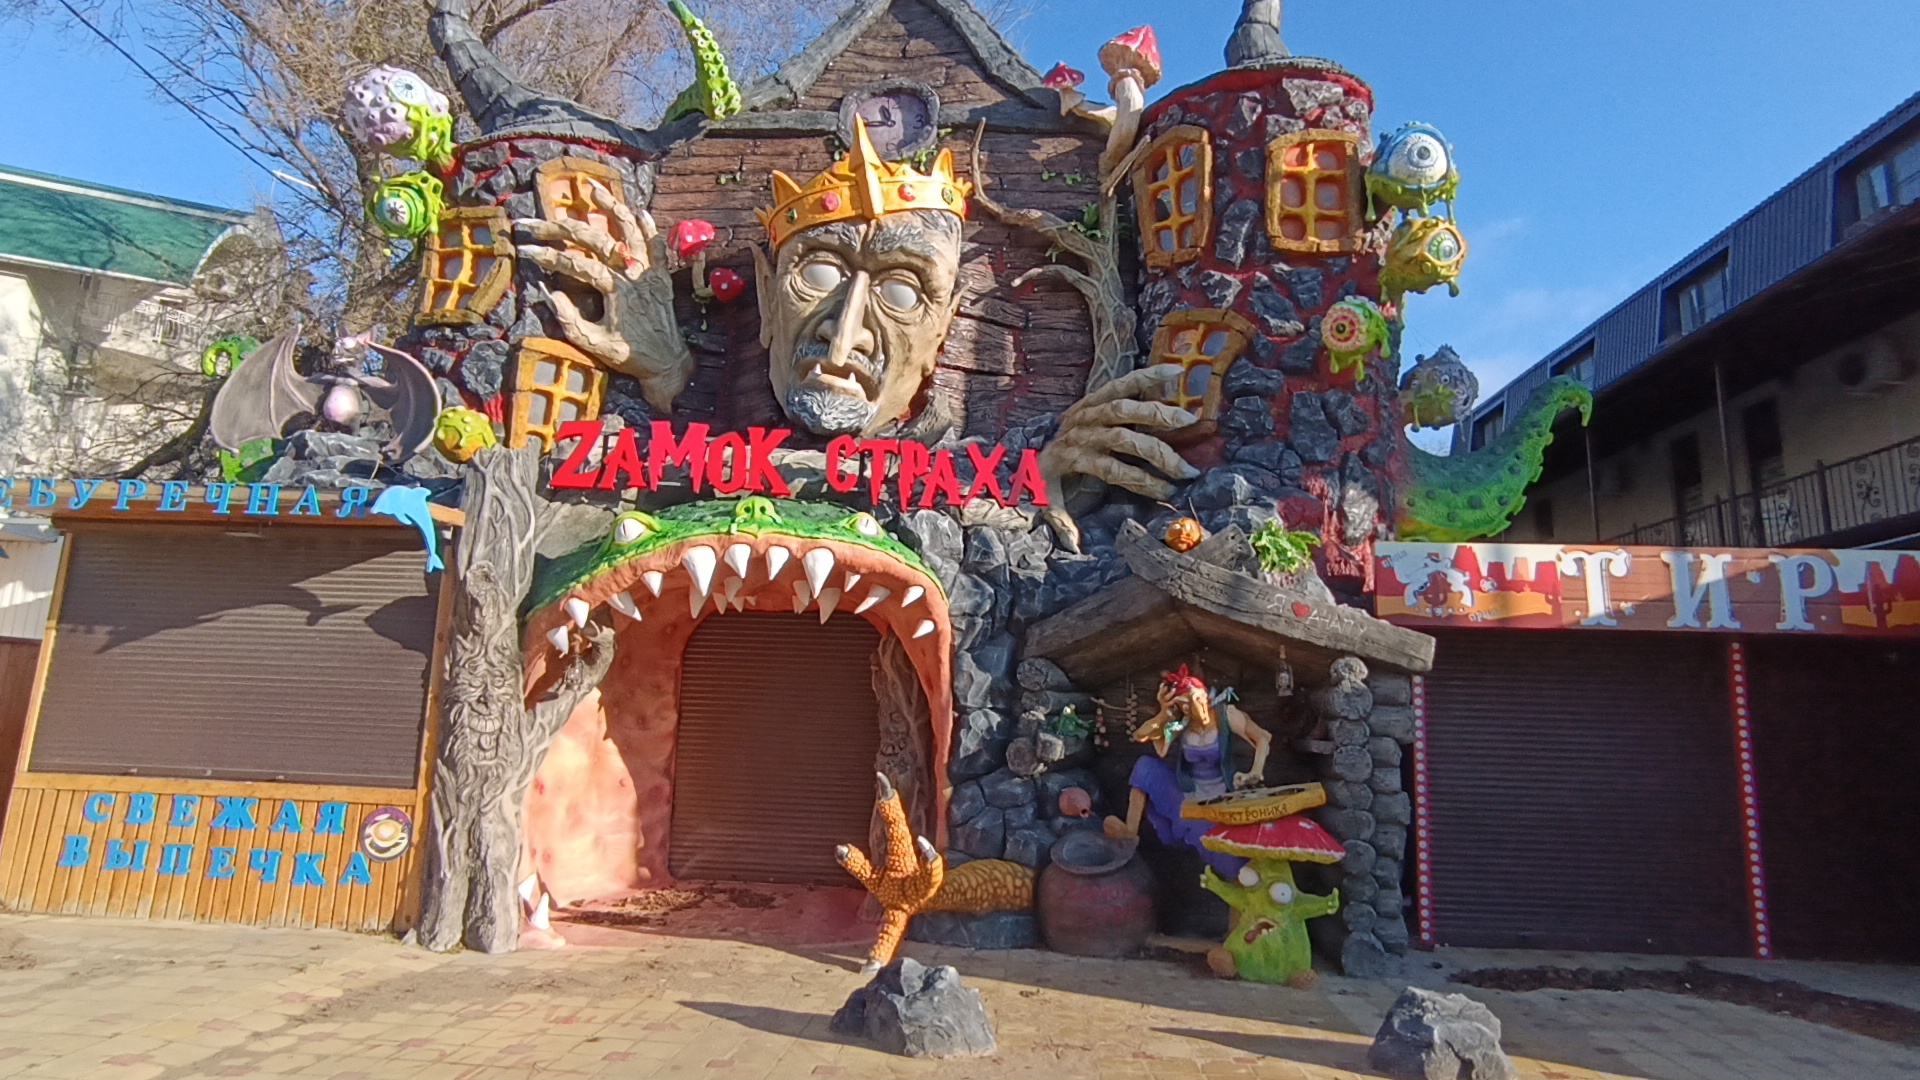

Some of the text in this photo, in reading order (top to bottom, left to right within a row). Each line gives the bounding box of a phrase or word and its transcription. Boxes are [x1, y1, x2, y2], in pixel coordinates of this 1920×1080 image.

[913, 114, 924, 130] 3
[826, 434, 1049, 513] СТРАХА
[1266, 593, 1287, 613] Я
[1556, 549, 1838, 631] ТИР
[83, 792, 349, 835] СВЕЖАЯ
[58, 835, 372, 887] ВЫПЕЧКА
